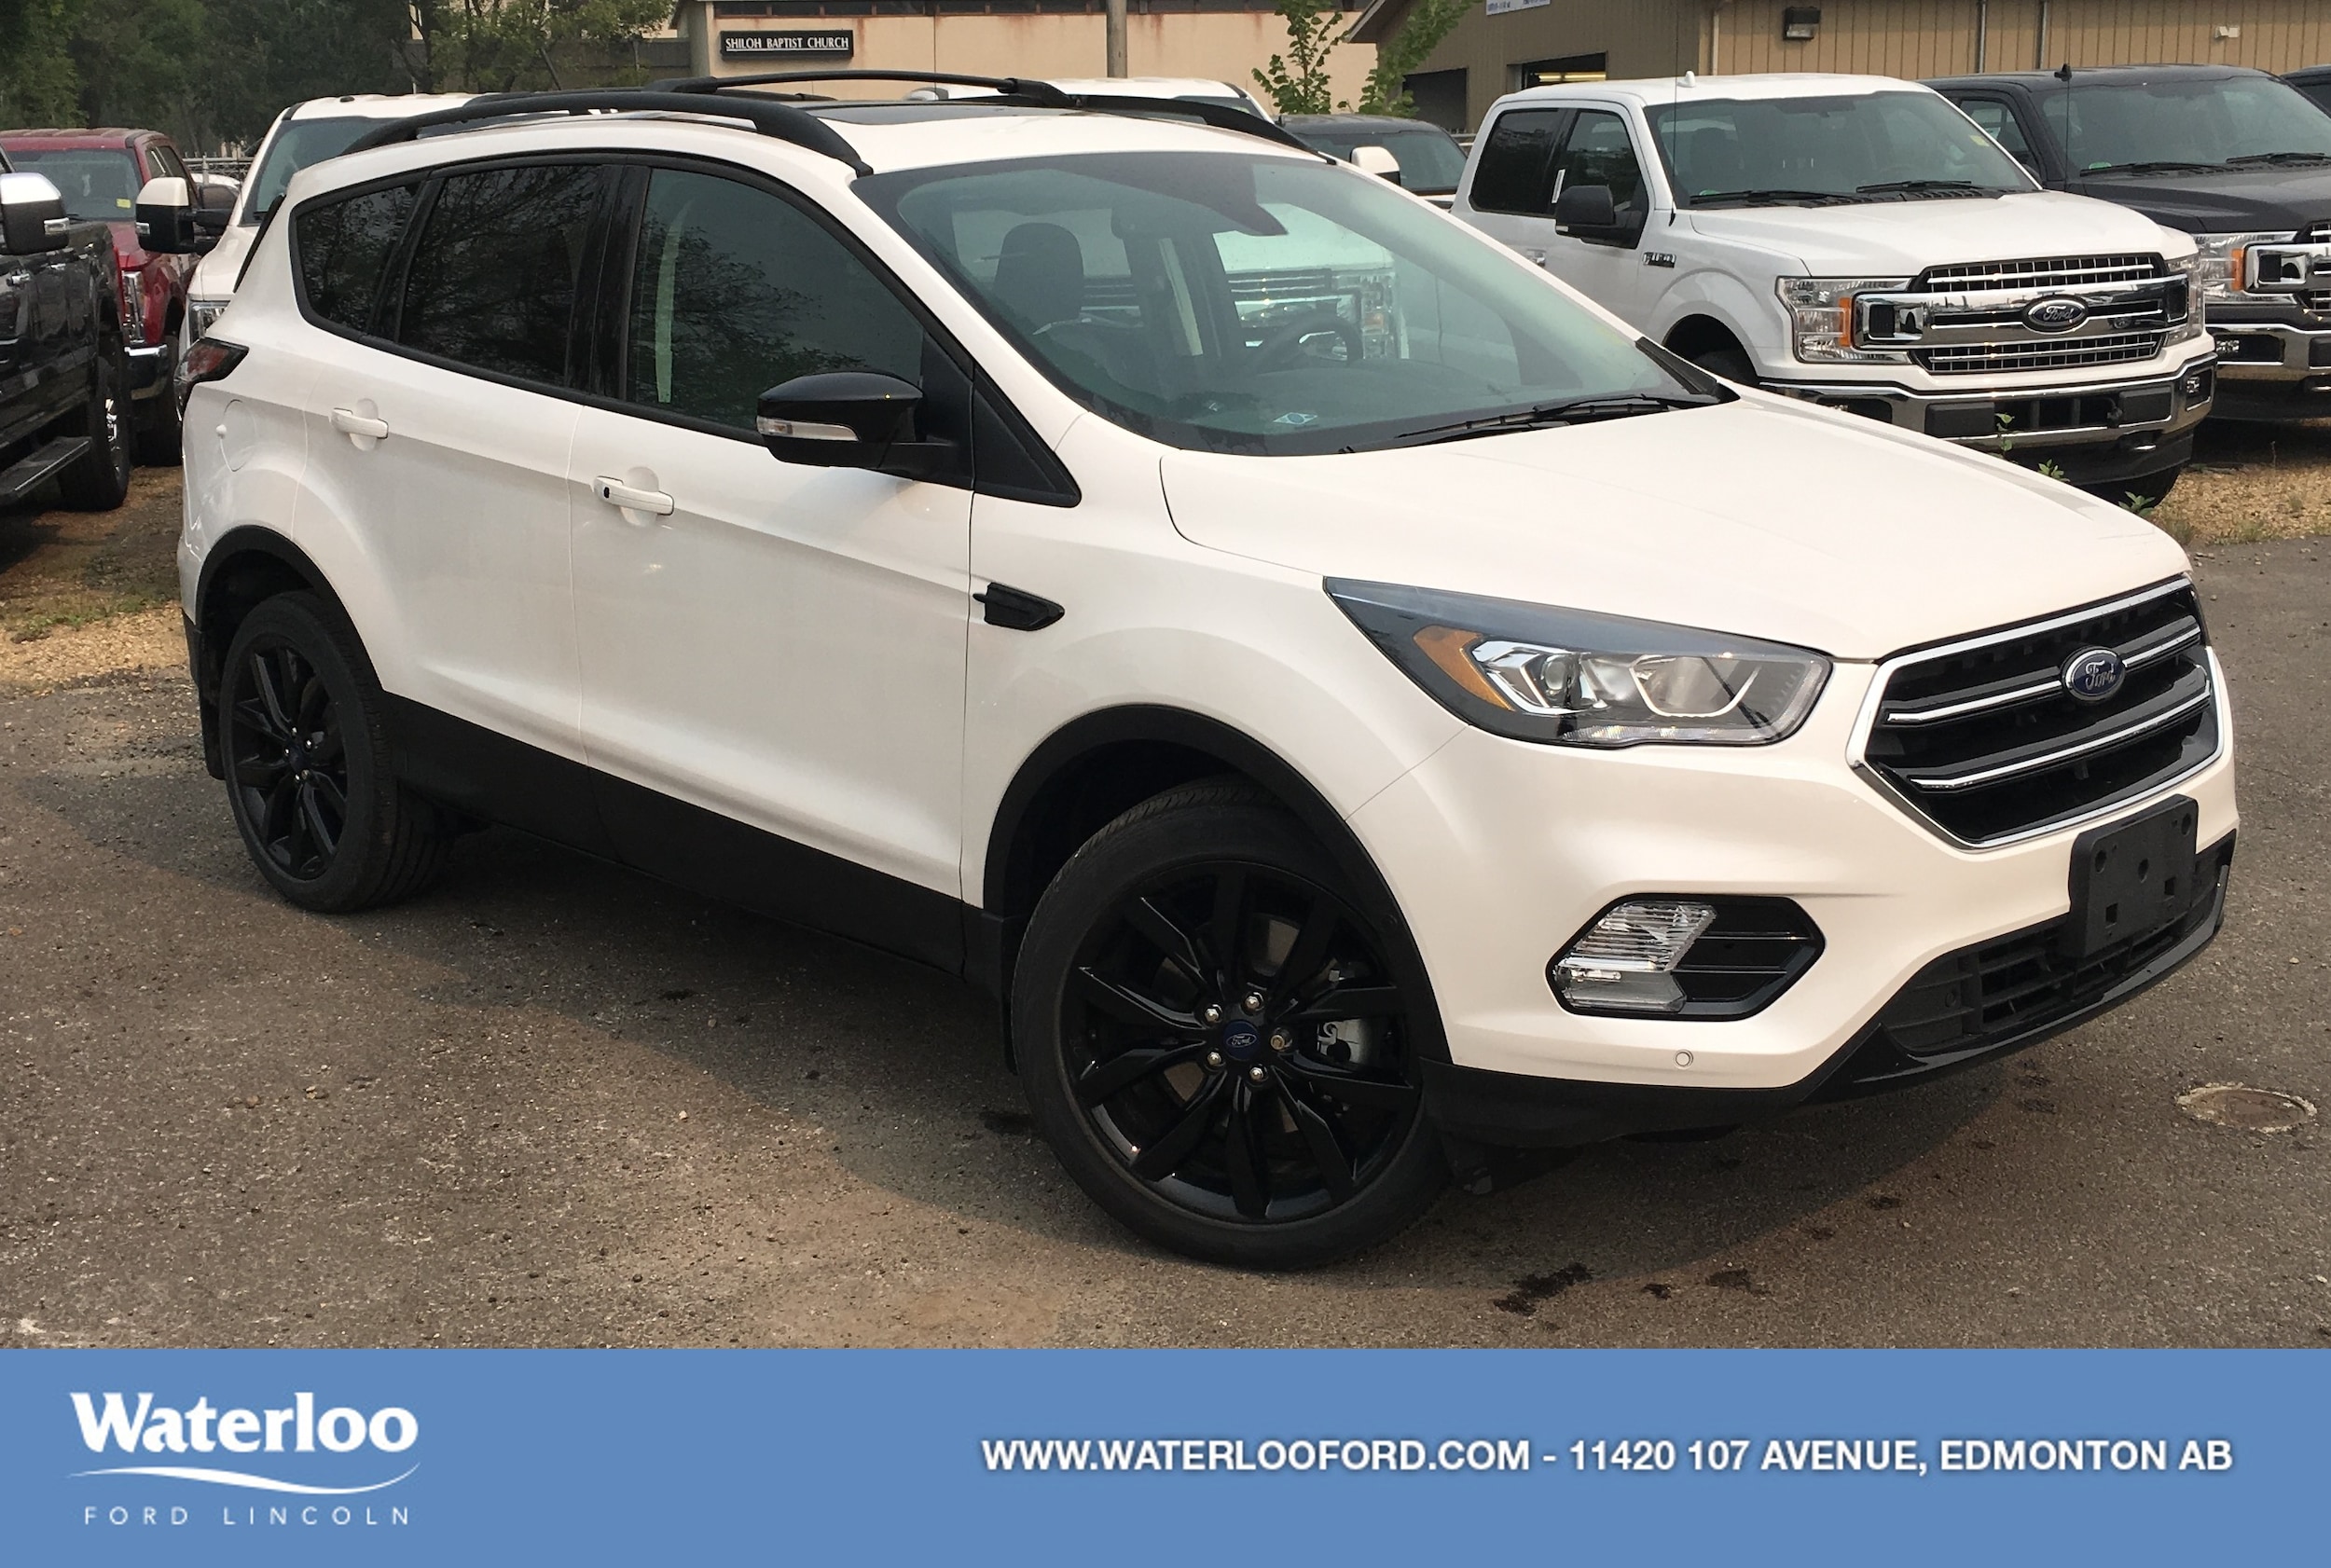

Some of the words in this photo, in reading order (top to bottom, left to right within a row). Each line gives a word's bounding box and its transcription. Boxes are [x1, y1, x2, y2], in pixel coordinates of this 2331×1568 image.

[725, 37, 762, 48] SHILOH
[766, 37, 803, 48] BAPTIST
[807, 37, 848, 48] CHURCH
[2043, 305, 2075, 321] Ford
[2085, 660, 2116, 690] Ford
